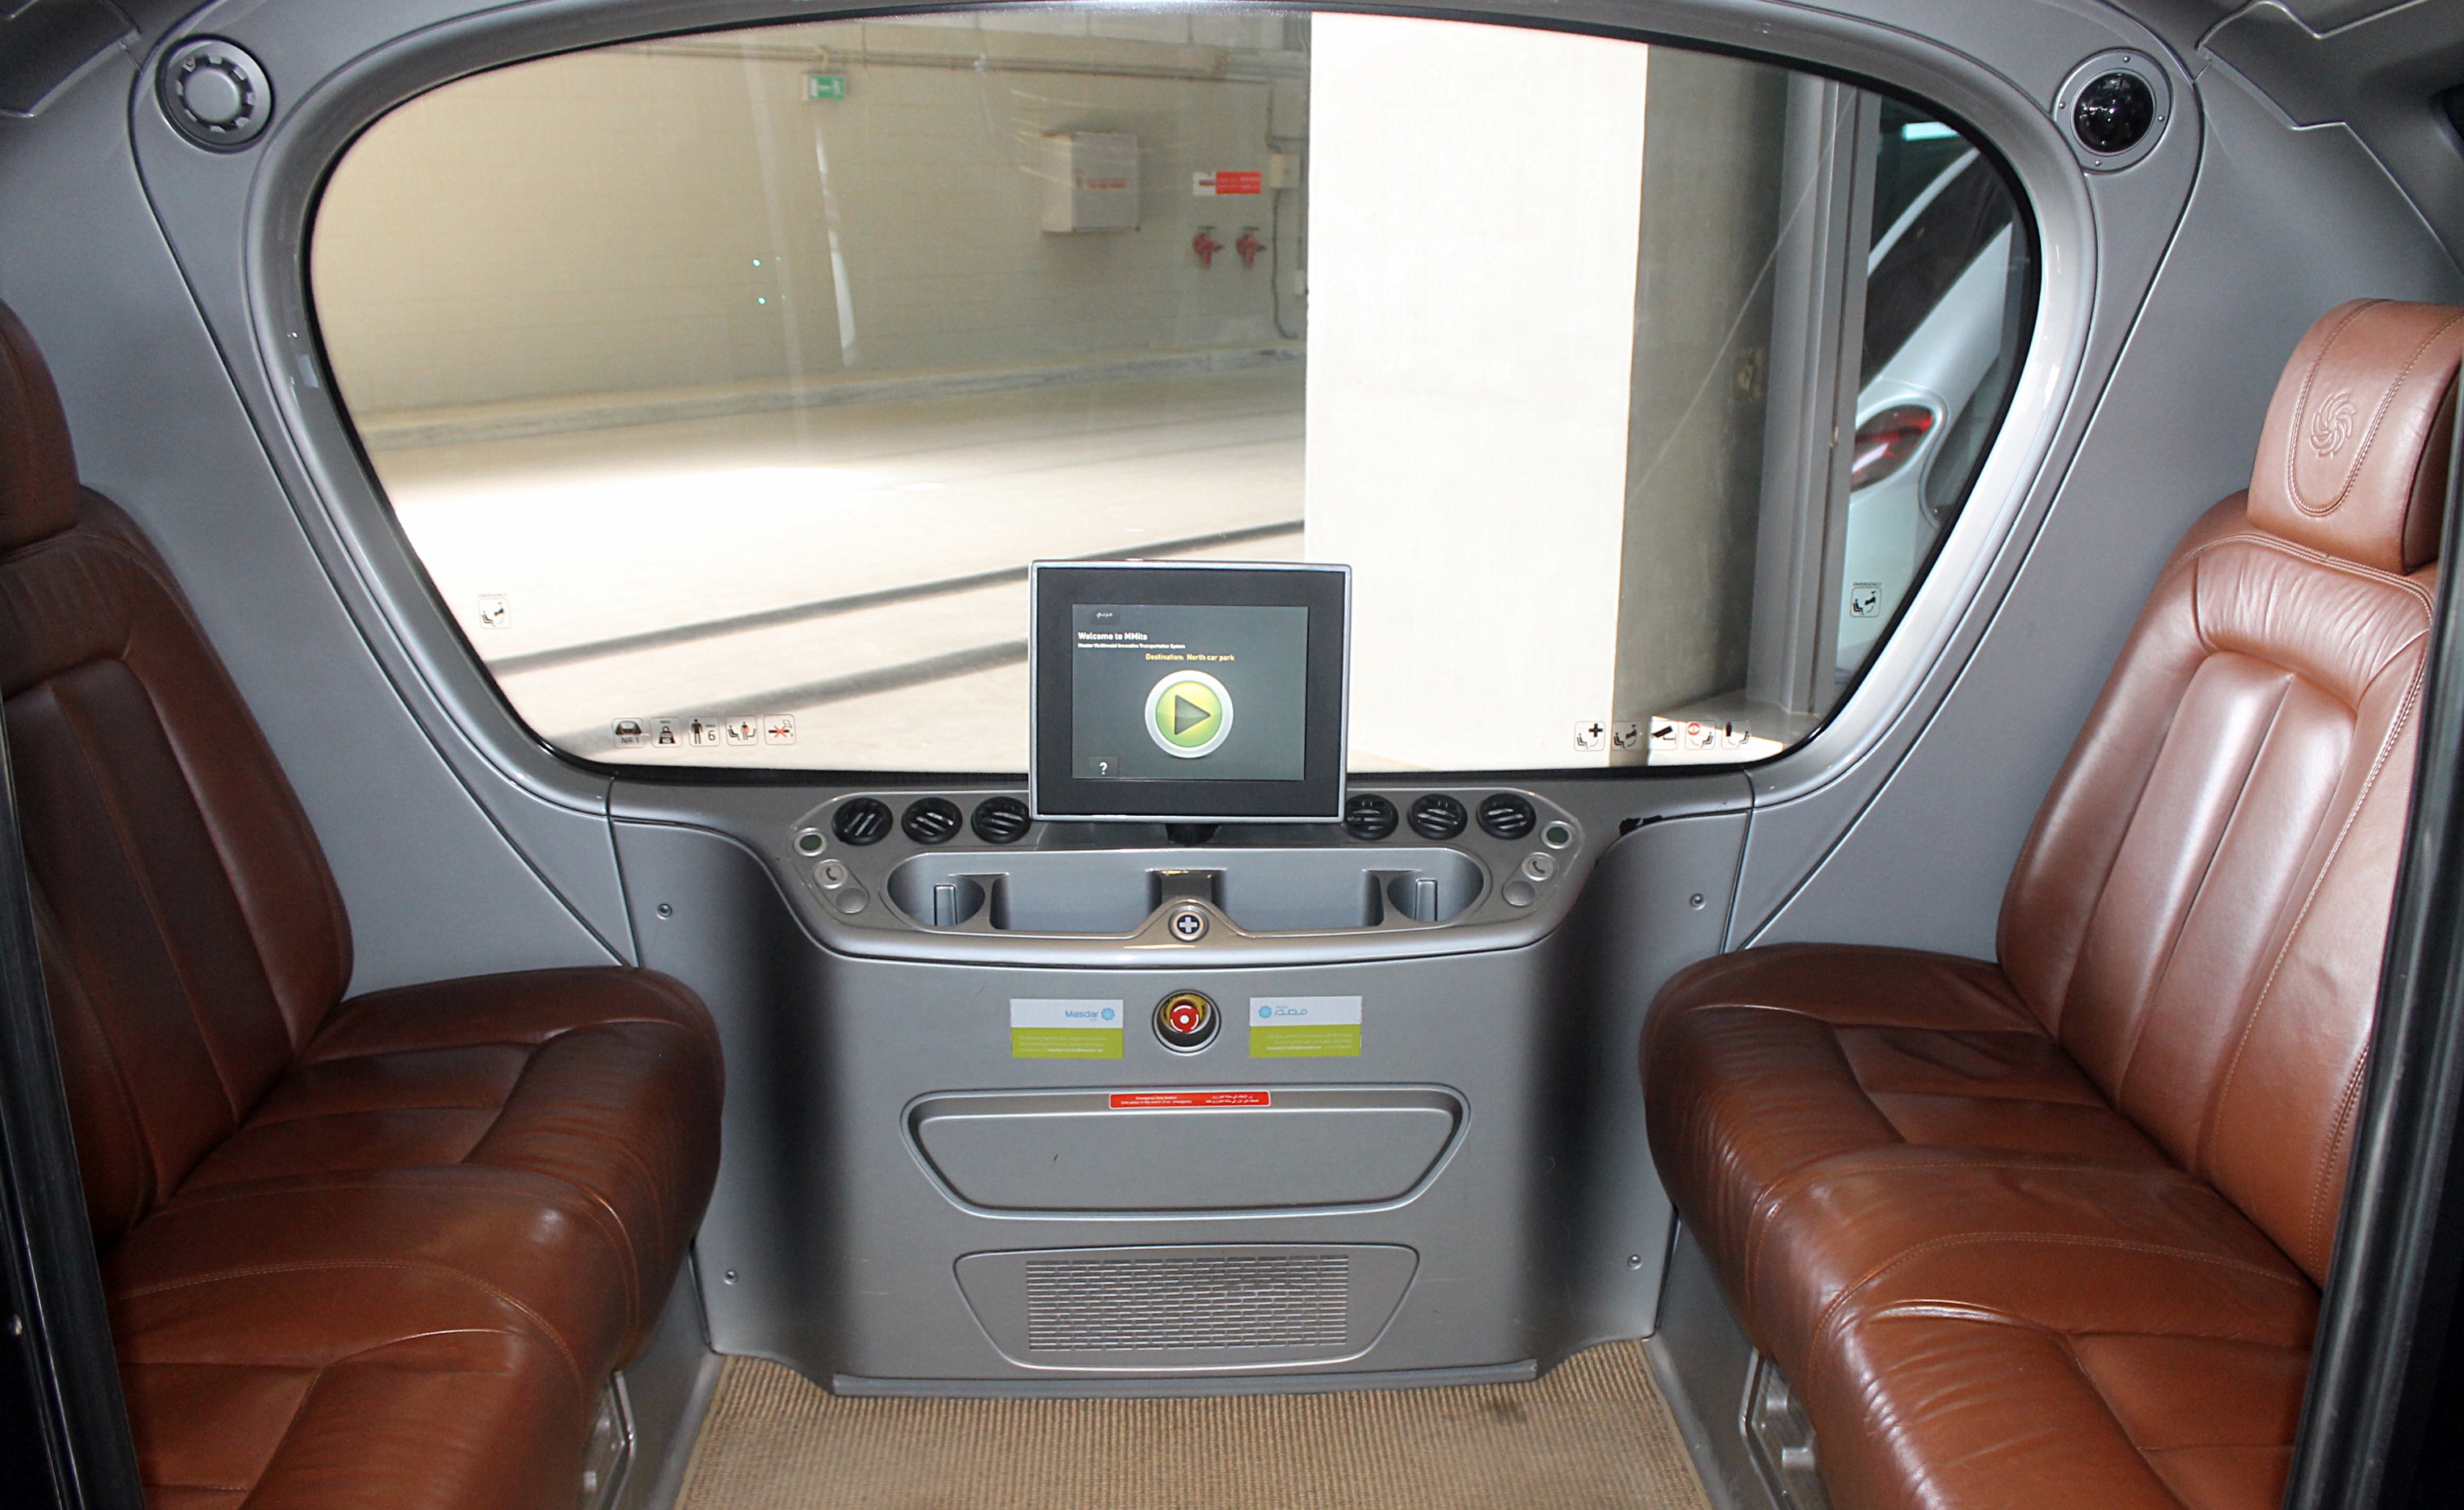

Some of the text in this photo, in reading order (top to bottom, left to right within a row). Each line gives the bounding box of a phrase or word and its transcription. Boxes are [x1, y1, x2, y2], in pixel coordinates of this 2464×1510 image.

[1078, 632, 1148, 641] Welcome to MMits
[1146, 653, 1184, 661] Destination:
[1219, 654, 1235, 662] park
[708, 730, 716, 741] 6
[1100, 762, 1108, 775] ?
[1065, 1010, 1099, 1018] Masdar
